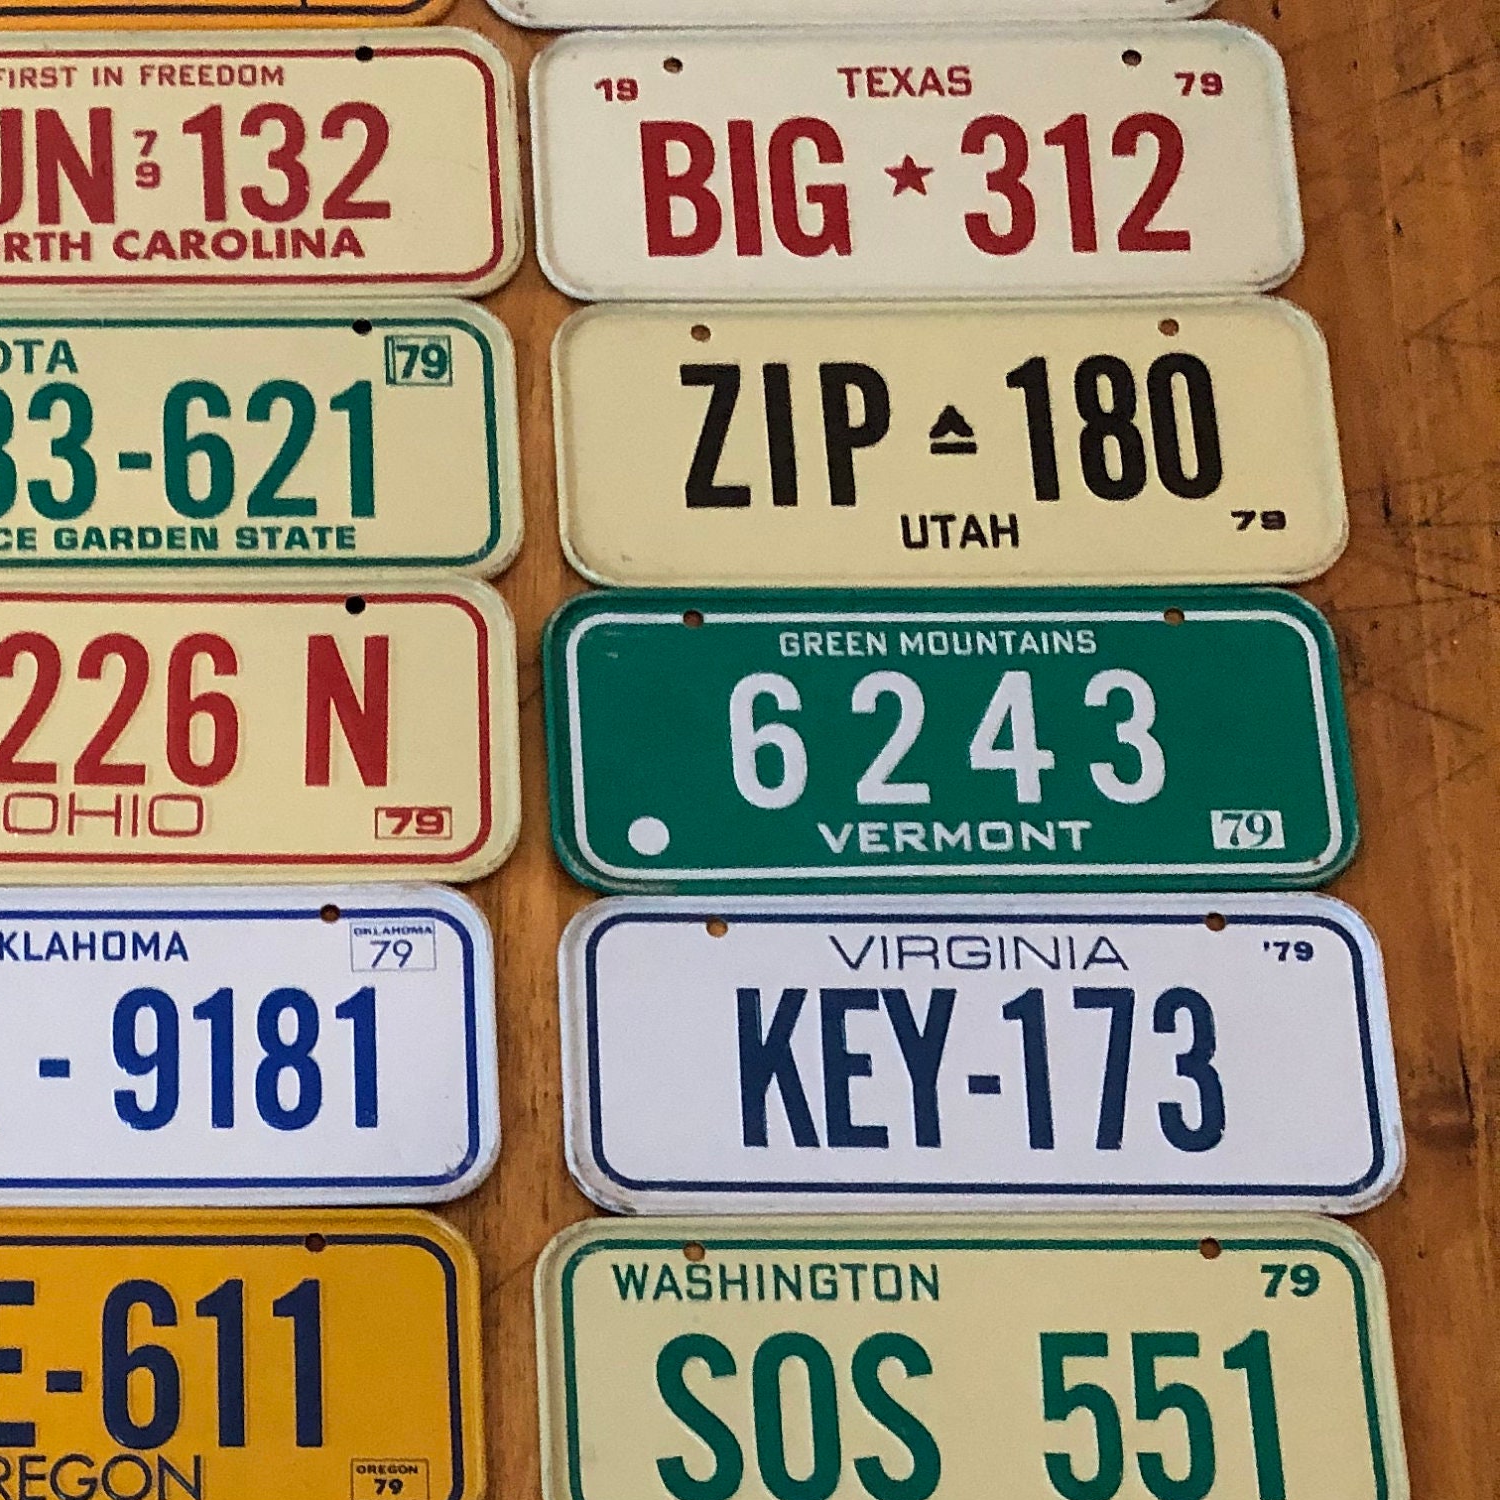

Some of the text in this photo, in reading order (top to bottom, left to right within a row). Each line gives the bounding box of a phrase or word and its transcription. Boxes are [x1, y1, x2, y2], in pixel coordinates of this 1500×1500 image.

[92, 66, 123, 88] IN
[140, 64, 285, 87] FREEDOM
[595, 78, 638, 102] 19
[837, 66, 973, 99] TEXAS
[1174, 72, 1224, 97] 79
[182, 102, 392, 222] 132
[639, 112, 1192, 257] BIG 312
[112, 226, 365, 261] CAROLINA
[396, 344, 448, 380] 79
[680, 351, 1224, 509] ZIP 180
[900, 513, 1019, 551] UTAH
[1231, 509, 1286, 531] 79
[53, 527, 219, 552] GARDEN
[235, 525, 357, 550] STATE
[779, 630, 1098, 658] GREEN MOUNTAINS
[304, 634, 390, 788] N
[3, 791, 204, 838] OHIO
[383, 811, 446, 835] 79
[1221, 812, 1274, 847] 79
[817, 821, 1093, 854] VERMONT
[370, 940, 413, 968] 79
[829, 935, 1129, 972] VIRGINIA
[111, 986, 379, 1131] 9181
[735, 986, 1227, 1154] KEY-173
[612, 1264, 940, 1301] WASHINGTON
[1261, 1264, 1320, 1298] 79
[356, 1465, 418, 1474] OREGON
[374, 1479, 403, 1495] 79
